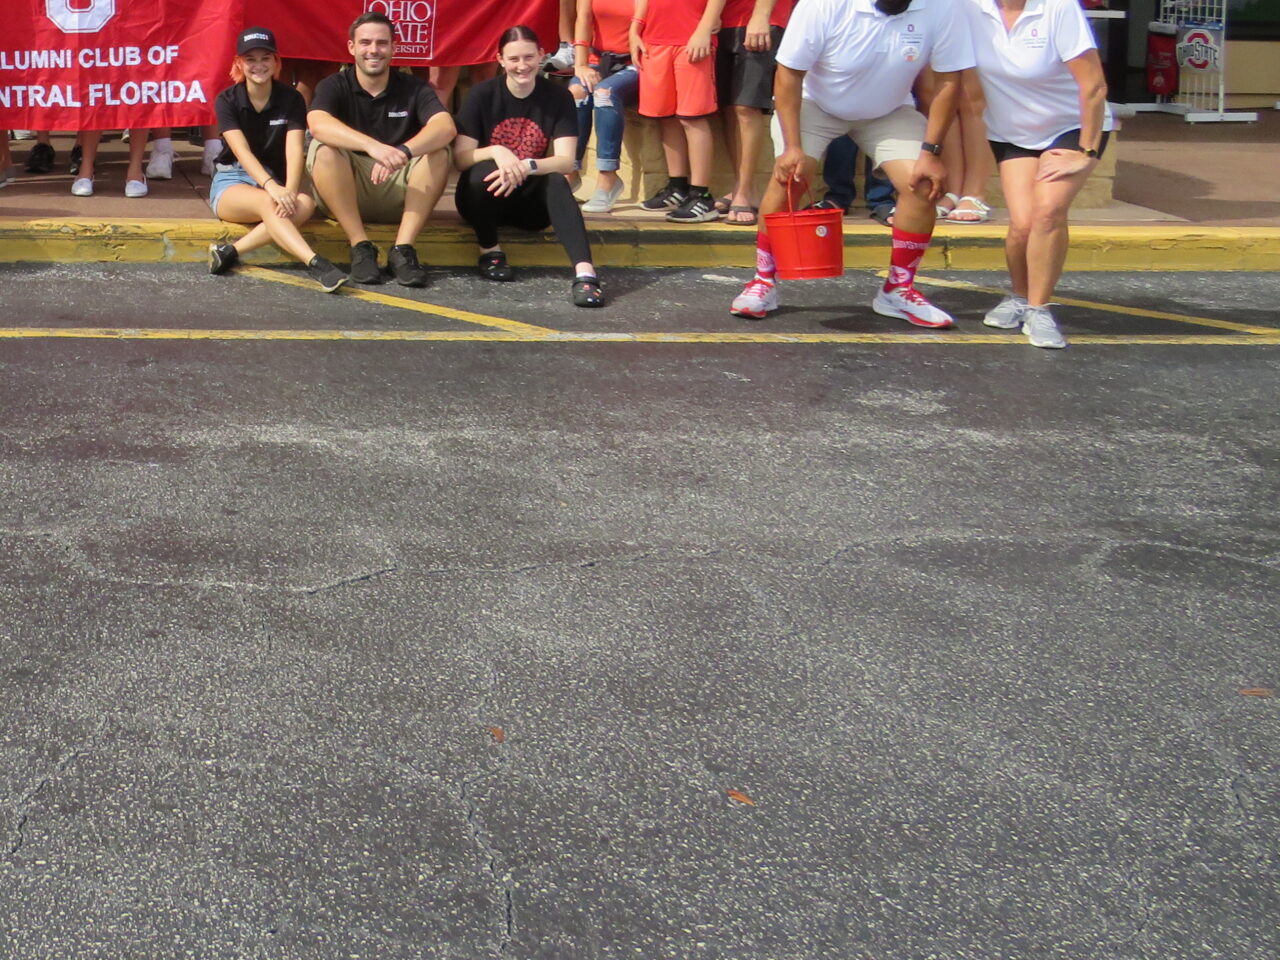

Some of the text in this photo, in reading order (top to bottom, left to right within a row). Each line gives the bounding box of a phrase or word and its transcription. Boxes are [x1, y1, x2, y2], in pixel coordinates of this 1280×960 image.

[368, 0, 432, 22] OHIO
[78, 46, 141, 68] CLUB
[147, 45, 179, 65] OF
[89, 80, 207, 107] FLORIDA
